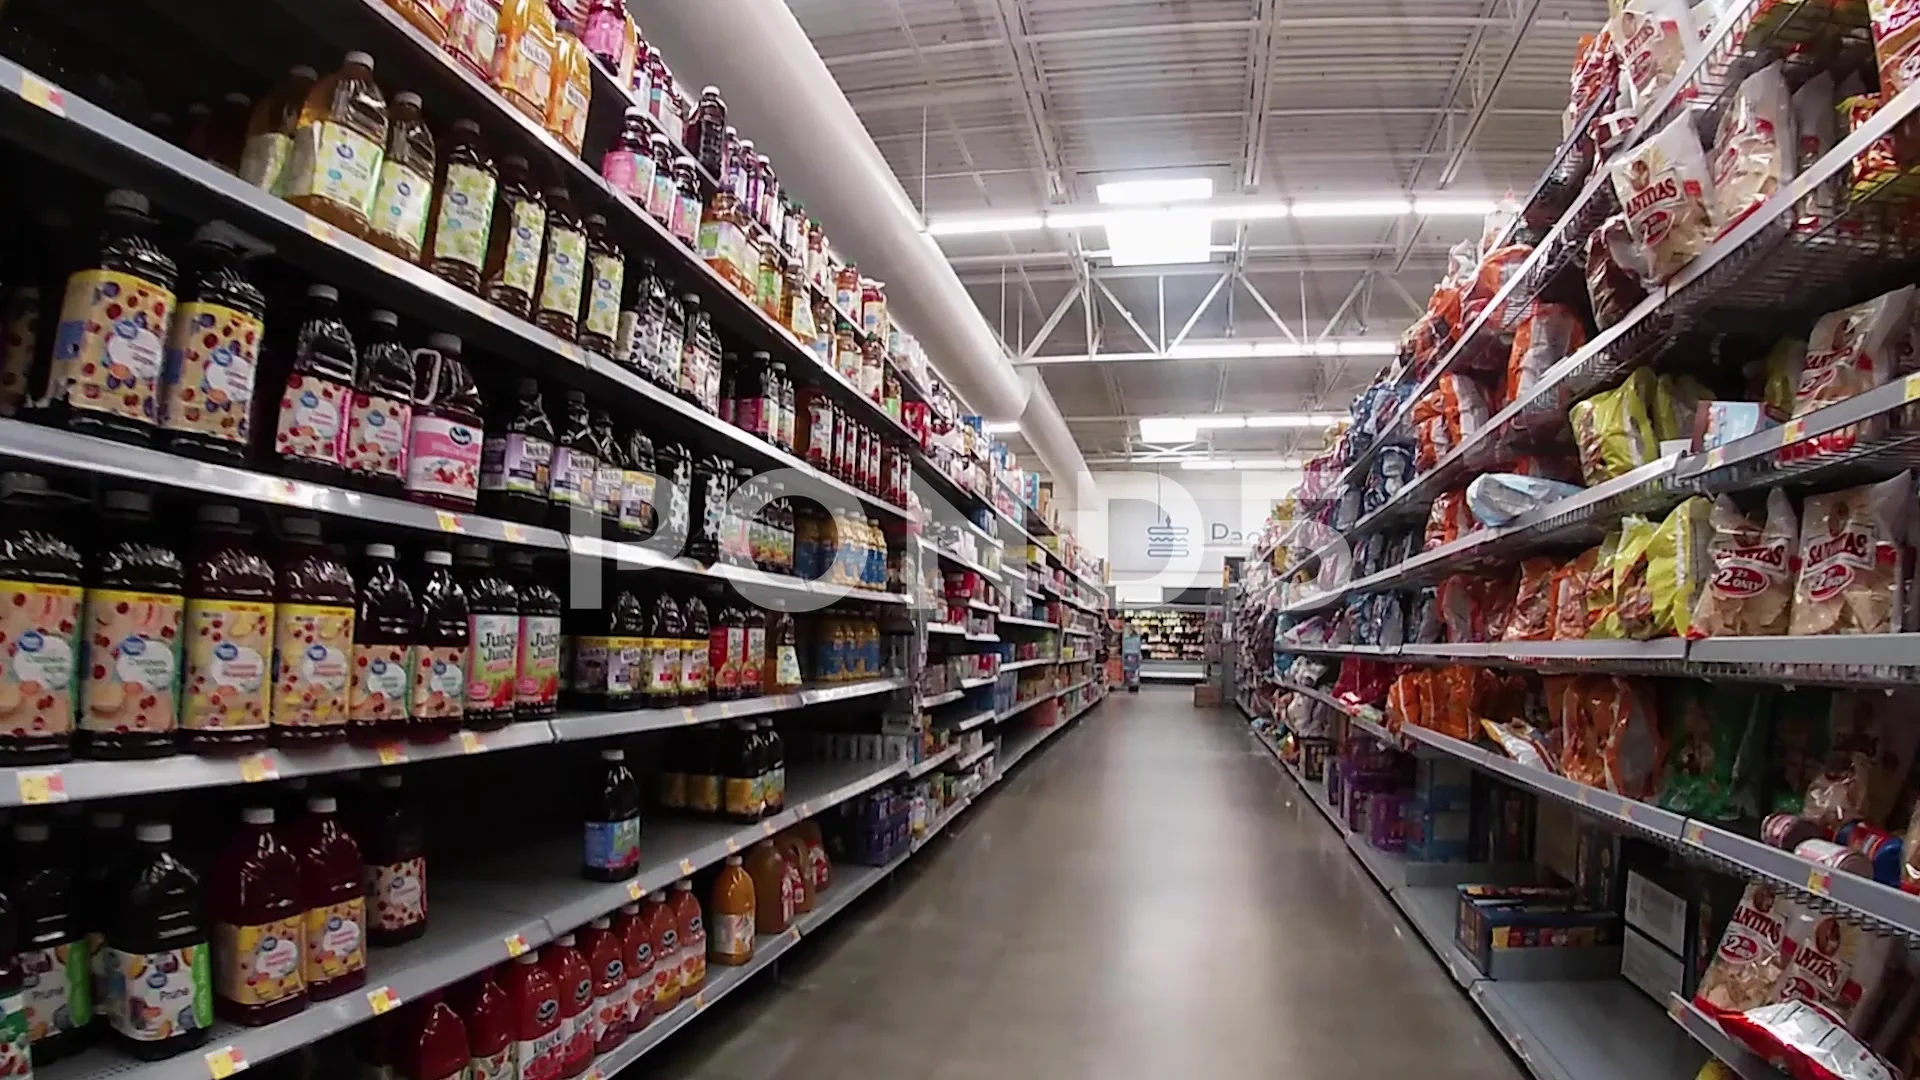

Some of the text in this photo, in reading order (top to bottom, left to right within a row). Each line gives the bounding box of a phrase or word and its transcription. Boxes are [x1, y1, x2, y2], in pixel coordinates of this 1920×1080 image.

[1625, 178, 1678, 218] ANTITAS
[480, 632, 517, 650] Juicy
[159, 987, 189, 1001] Prune
